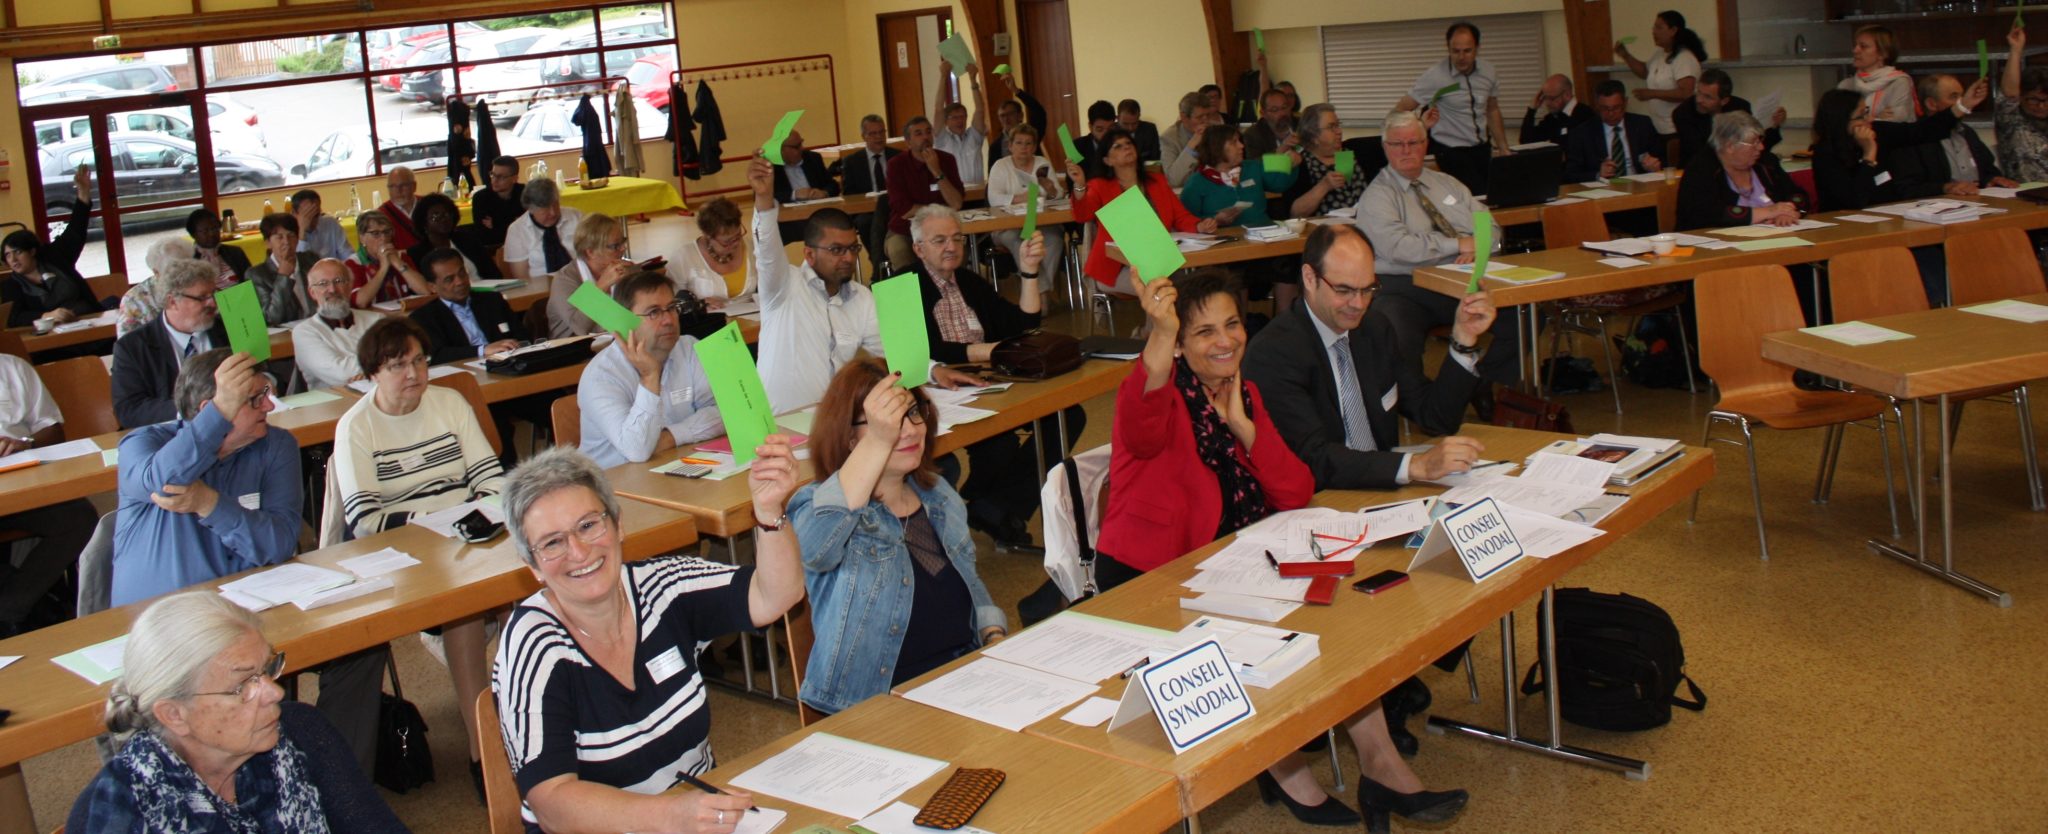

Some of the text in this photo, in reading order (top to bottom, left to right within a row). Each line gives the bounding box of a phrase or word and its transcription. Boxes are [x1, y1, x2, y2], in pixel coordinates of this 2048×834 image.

[1457, 512, 1501, 543] CONSEIL
[1466, 530, 1514, 565] SYNODAL
[1159, 660, 1224, 702] CONSEIL
[1168, 683, 1239, 730] SYNODAL
